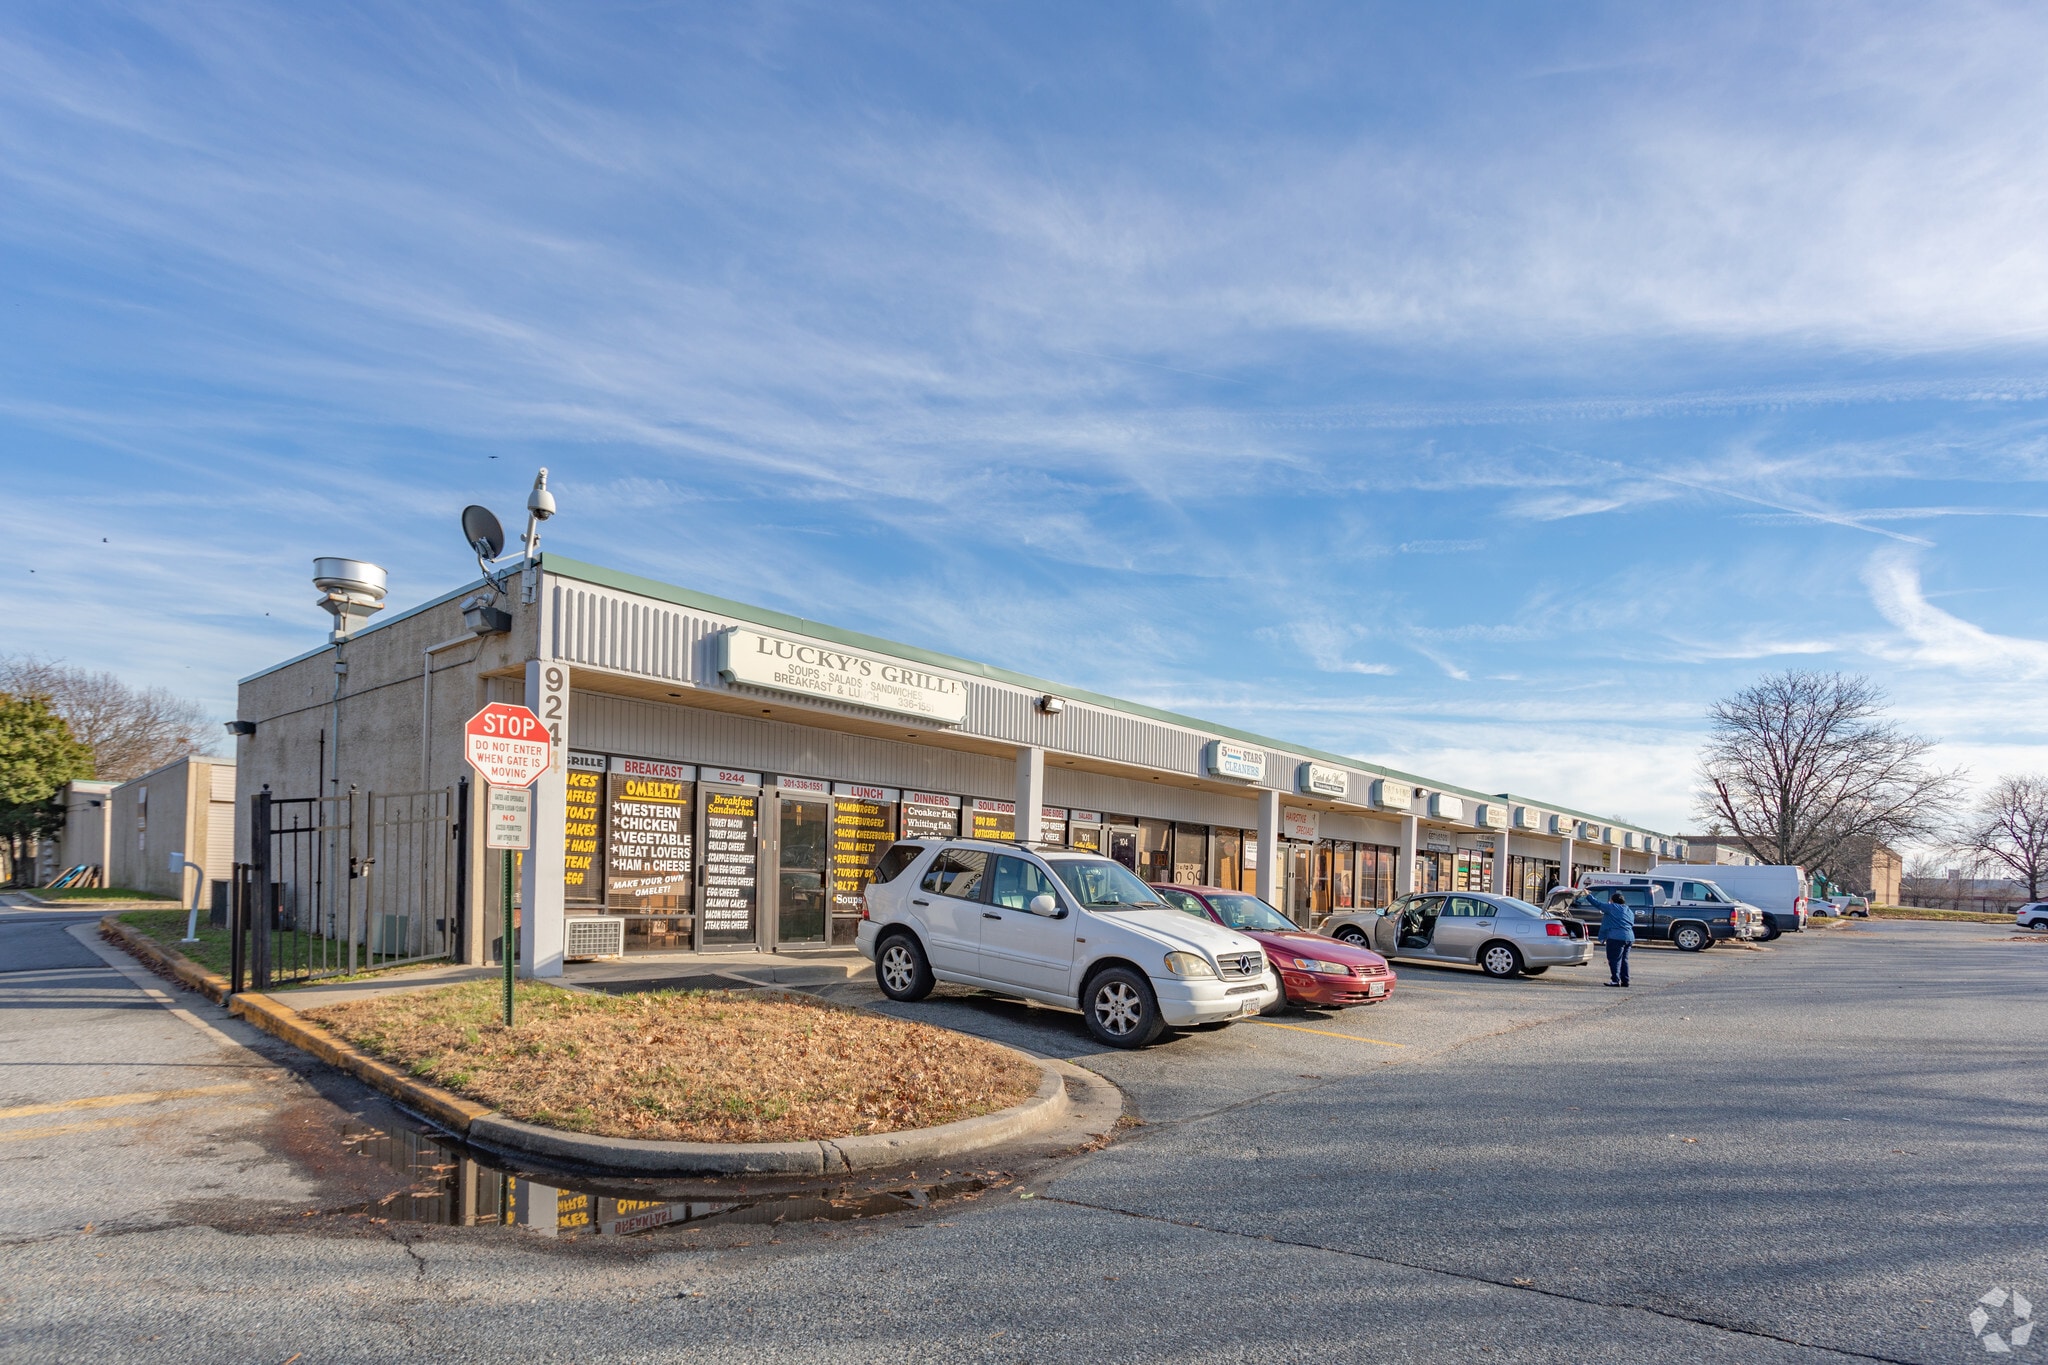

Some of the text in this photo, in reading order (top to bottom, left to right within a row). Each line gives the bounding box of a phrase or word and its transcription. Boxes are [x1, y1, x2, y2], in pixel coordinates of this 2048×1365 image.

[757, 636, 871, 677] LUCKY'S
[774, 671, 833, 693] BREAKFAST
[837, 685, 844, 695] &
[788, 664, 923, 700] SOUPS SALADS SANDWICHES
[484, 713, 535, 737] STOP
[475, 740, 542, 755] DO NOT ENTER
[477, 753, 540, 768] WHEN GATE IS
[1221, 746, 1262, 764] 5 STARS
[491, 767, 527, 778] MOVING
[624, 760, 684, 778] BREAKFAST
[1225, 760, 1259, 777] CLEANERS
[719, 771, 745, 783] 9244
[625, 780, 681, 799] OMELETS
[783, 779, 824, 791] 301-336-1551
[566, 789, 597, 804] AFFLES
[851, 786, 883, 800] LUNCH
[914, 793, 949, 806] DINNERS
[713, 794, 754, 807] Breakfast
[978, 801, 1014, 813] SOUL FOOD
[565, 805, 597, 820] TOAST
[620, 803, 681, 819] WESTERN
[708, 803, 755, 817] Sandwiches
[838, 802, 879, 814] HAMBURGERS
[907, 807, 957, 819] Croaker fish
[837, 815, 885, 828] CHEESEBURGERS
[1078, 812, 1093, 820] SALADS
[620, 817, 677, 832] CHICKEN
[709, 818, 743, 829] TURKEY BACON
[907, 819, 952, 830] Whitting fish
[620, 831, 691, 846] VEGETABLE
[709, 829, 747, 840] TURKEY SAUSAGE
[837, 829, 856, 838] BACON
[1081, 833, 1090, 841] 101
[571, 839, 597, 852] HASH
[708, 841, 745, 852] GRILLED CHEESE
[837, 842, 875, 852] TUNA MELTS
[1119, 838, 1128, 846] 104
[618, 844, 690, 859] MEAT LOVERS
[564, 855, 592, 870] TEAK
[618, 859, 691, 872] HAM n CHEESE
[837, 855, 869, 865] REUBENS
[837, 868, 864, 878] TURKEY
[613, 874, 684, 890] MAKE YOUR OWN
[837, 881, 858, 891] BLT'S
[635, 885, 671, 897] OMELET!
[705, 898, 747, 909] SALMON CAKES
[836, 894, 863, 907] Soups
